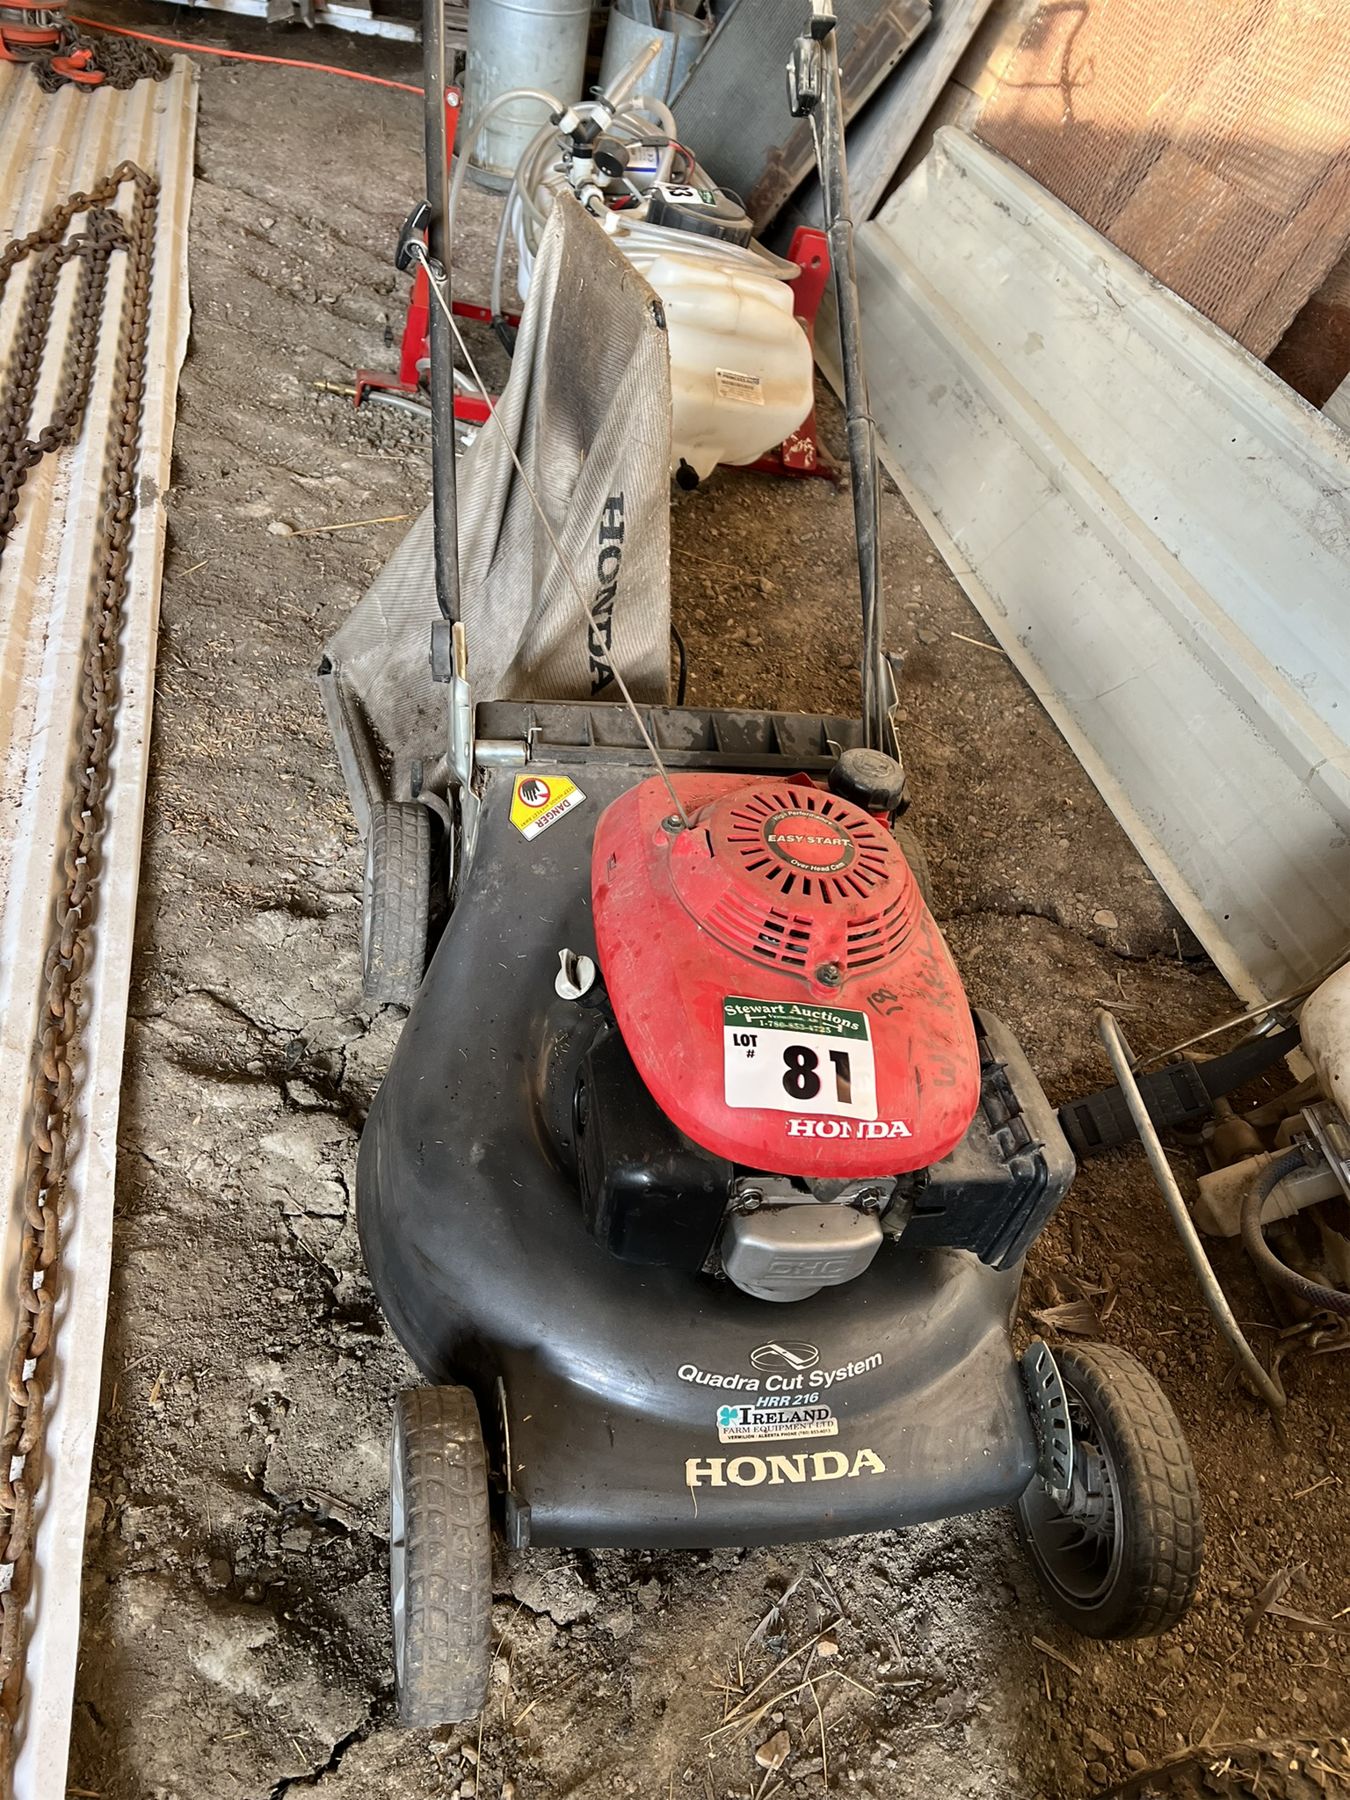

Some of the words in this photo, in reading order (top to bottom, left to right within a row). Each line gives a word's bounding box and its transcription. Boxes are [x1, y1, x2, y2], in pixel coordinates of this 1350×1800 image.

[588, 491, 625, 696] HONDA
[535, 799, 571, 828] DANGER
[767, 834, 804, 843] EASY
[807, 836, 851, 847] START
[790, 859, 810, 870] Over
[810, 864, 830, 873] Head
[724, 1004, 785, 1016] Stewart
[790, 1004, 860, 1031] Auctions
[733, 1033, 758, 1048] LOT
[745, 1049, 756, 1059] #
[782, 1045, 853, 1105] 81
[787, 1118, 912, 1139] HONDA
[677, 1364, 760, 1392] Quadra
[765, 1374, 804, 1392] Cut
[808, 1352, 884, 1389] System
[756, 1396, 791, 1408] HRR
[792, 1392, 820, 1406] 216
[739, 1406, 830, 1426] IRELAND
[723, 1426, 751, 1434] FARM
[753, 1423, 814, 1433] EQUIPMENT
[815, 1420, 834, 1428] LTD
[685, 1448, 886, 1487] HONDA
